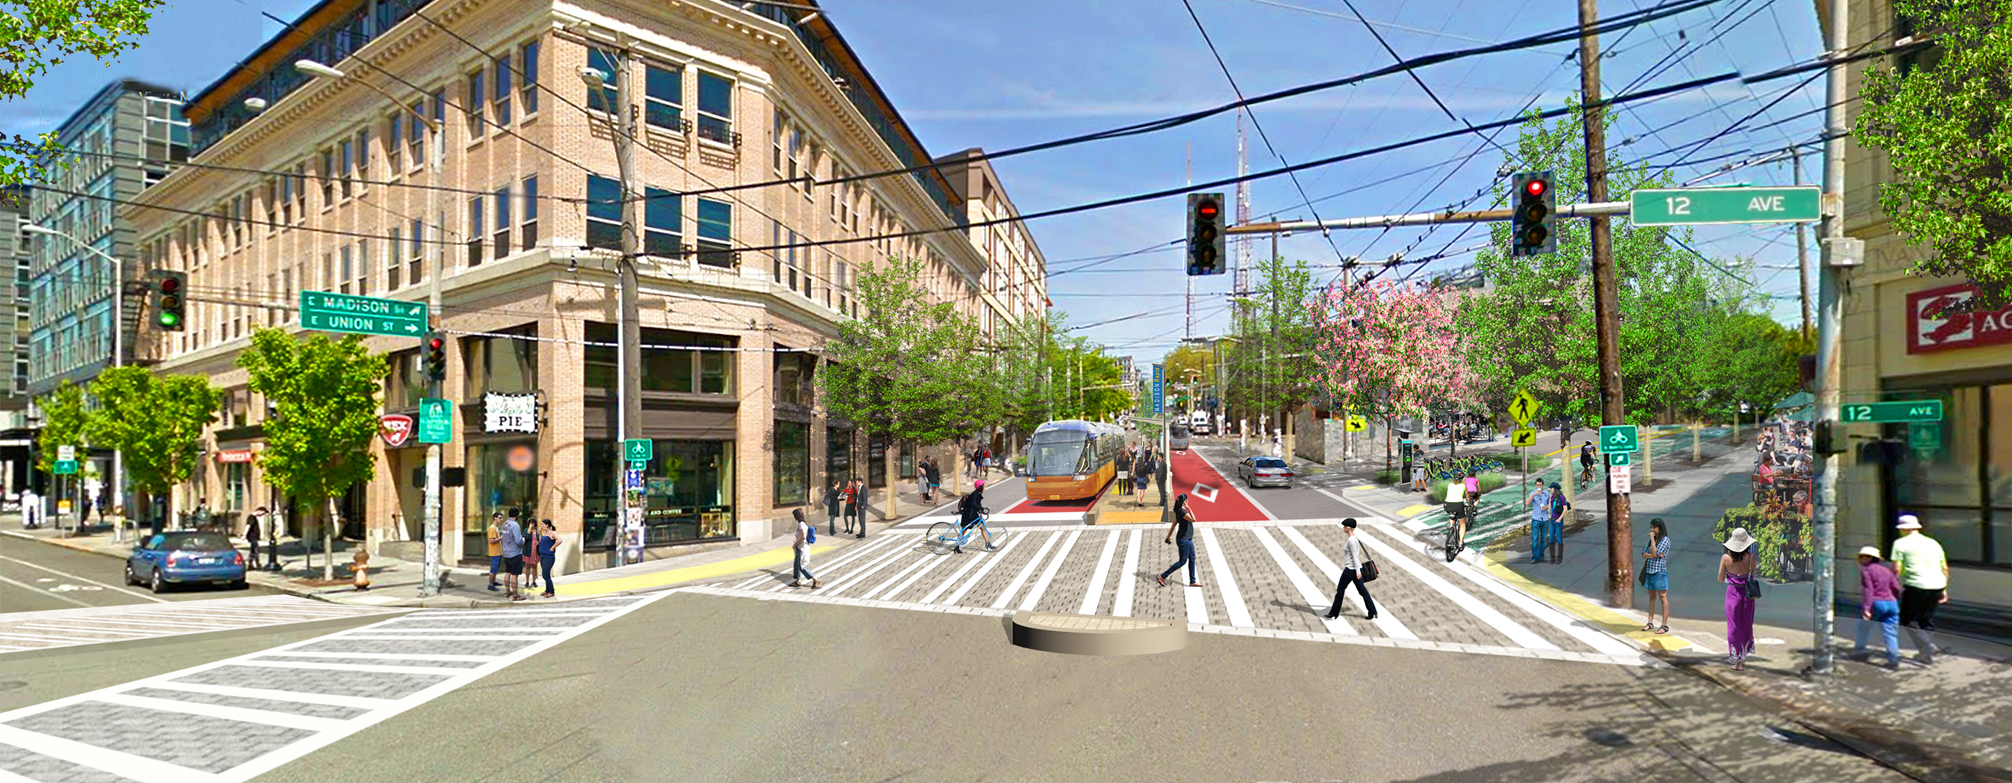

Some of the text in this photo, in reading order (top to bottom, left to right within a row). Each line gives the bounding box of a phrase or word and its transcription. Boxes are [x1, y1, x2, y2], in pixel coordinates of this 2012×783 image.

[1666, 196, 1785, 215] 12 AVE
[308, 296, 315, 306] E
[323, 297, 389, 314] MADISON
[311, 316, 394, 331] E UNION ST
[1847, 405, 1933, 421] 12 AVE
[499, 416, 523, 427] PIE
